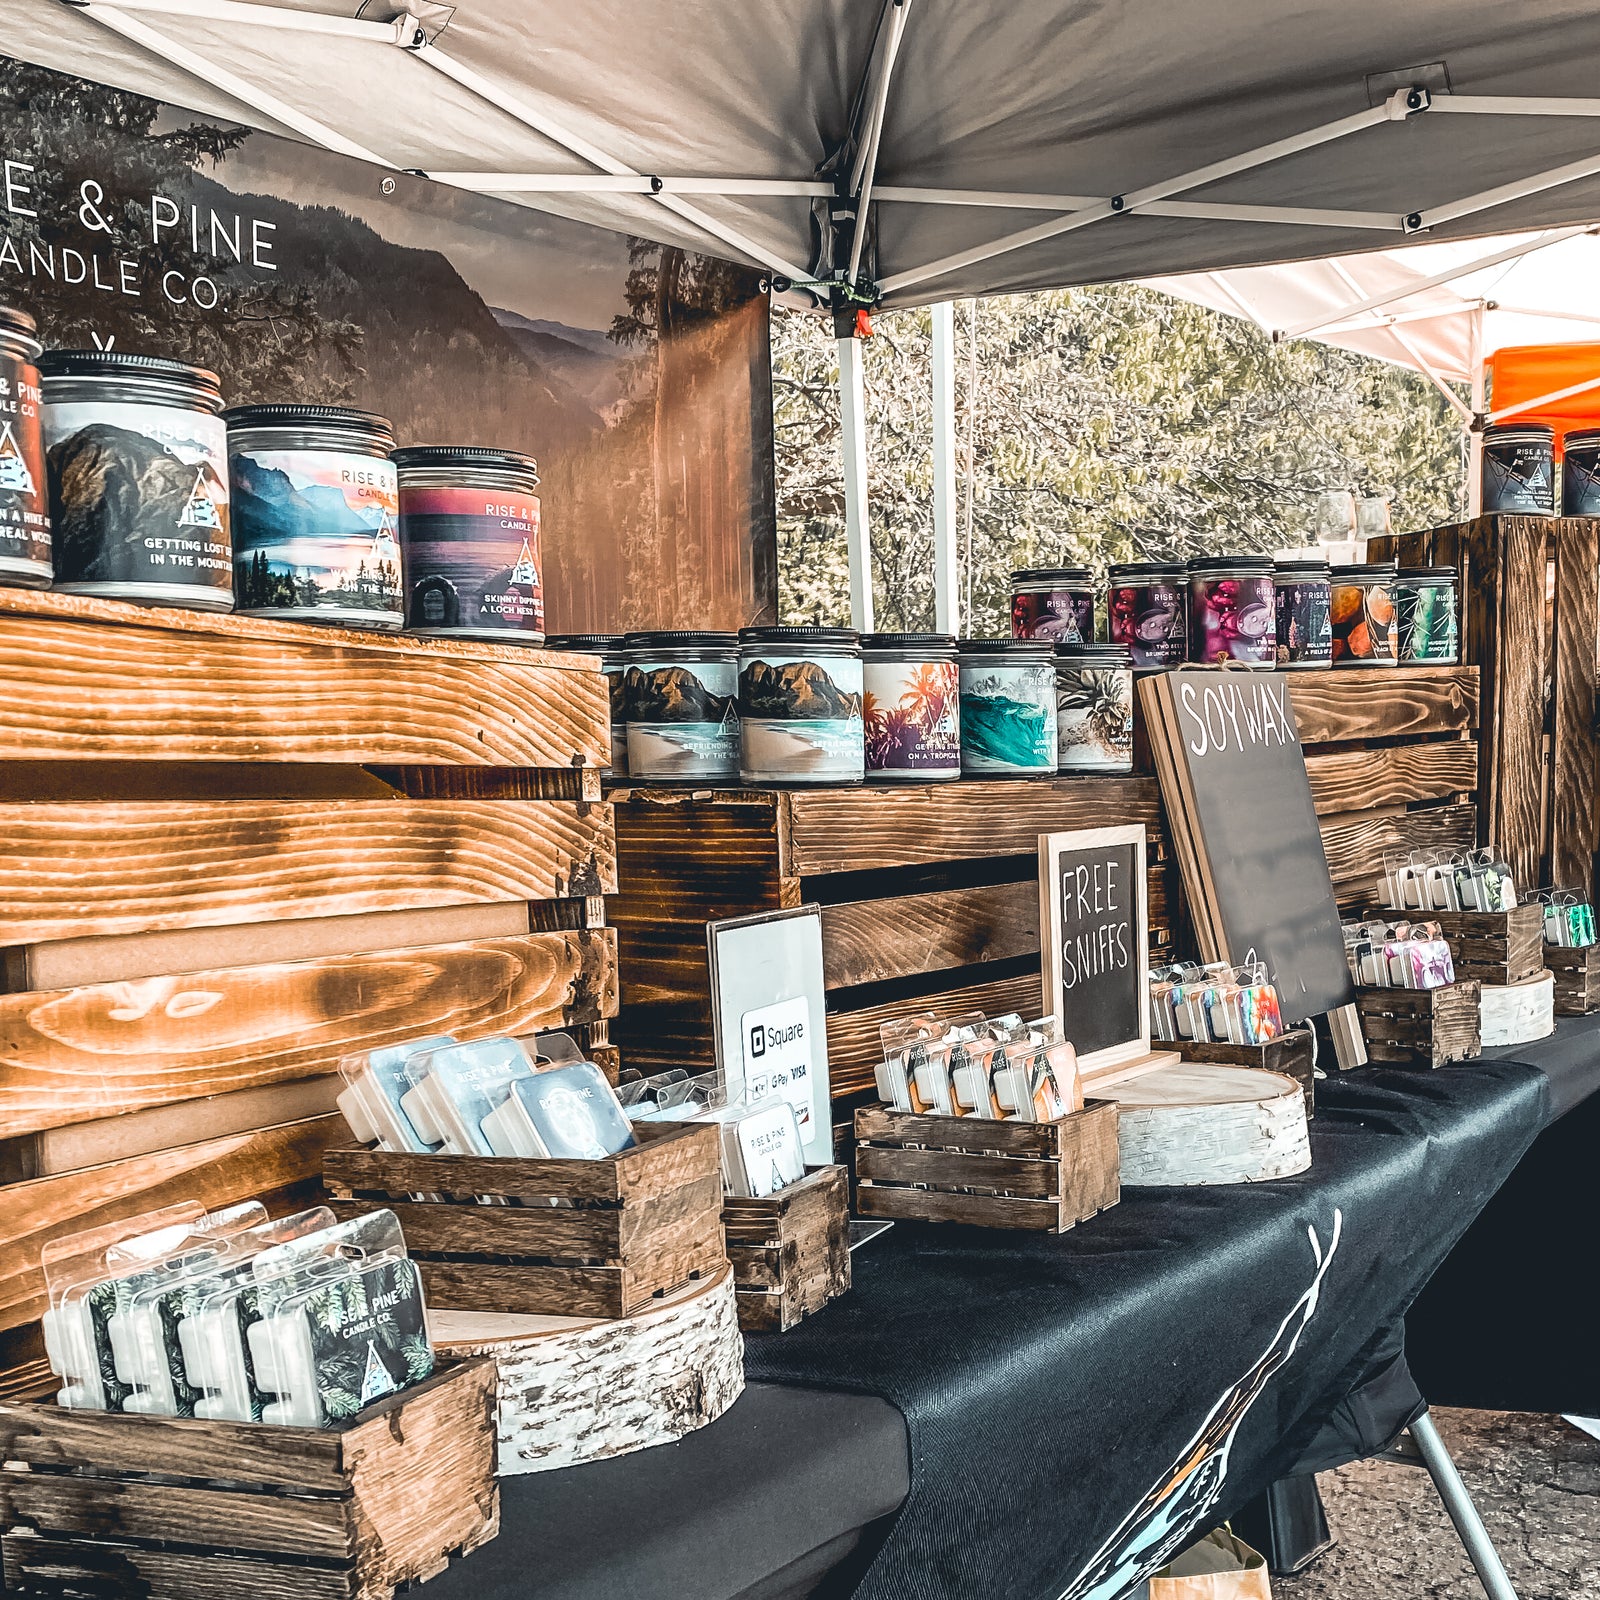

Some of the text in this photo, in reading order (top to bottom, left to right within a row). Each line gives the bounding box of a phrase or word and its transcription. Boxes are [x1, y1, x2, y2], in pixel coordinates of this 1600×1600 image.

[78, 179, 114, 234] &
[151, 194, 278, 271] PINE
[162, 270, 229, 313] CO.
[17, 381, 44, 405] PINE
[21, 403, 35, 417] CO
[1516, 448, 1534, 456] RISE
[341, 469, 374, 486] RISE
[380, 475, 387, 488] &
[357, 488, 390, 502] CANDLE
[12, 509, 20, 522] A
[485, 503, 516, 518] RISE
[521, 507, 528, 520] &
[500, 519, 531, 532] CANDLE
[144, 537, 201, 552] GETTING
[204, 542, 224, 555] LOST
[150, 553, 165, 565] IN
[169, 554, 194, 567] THE
[341, 581, 358, 592] ON
[361, 584, 380, 595] THE
[484, 594, 518, 603] SKINNY
[1047, 600, 1066, 608] RISE
[1077, 600, 1091, 608] PINE
[1154, 593, 1173, 601] RISE
[480, 605, 488, 613] A
[490, 605, 515, 615] LOCH
[516, 607, 533, 616] NESS
[1028, 677, 1048, 686] RISE
[915, 743, 945, 752] GETTING
[700, 752, 711, 760] BY
[908, 752, 920, 760] ON
[1062, 861, 1119, 923] FREE
[1062, 922, 1128, 990] SNIFFS
[767, 1023, 803, 1050] Square
[992, 1057, 1006, 1069] RISE
[790, 1064, 807, 1081] VISA
[372, 1289, 400, 1315] PINE
[342, 1317, 376, 1339] CANDLE
